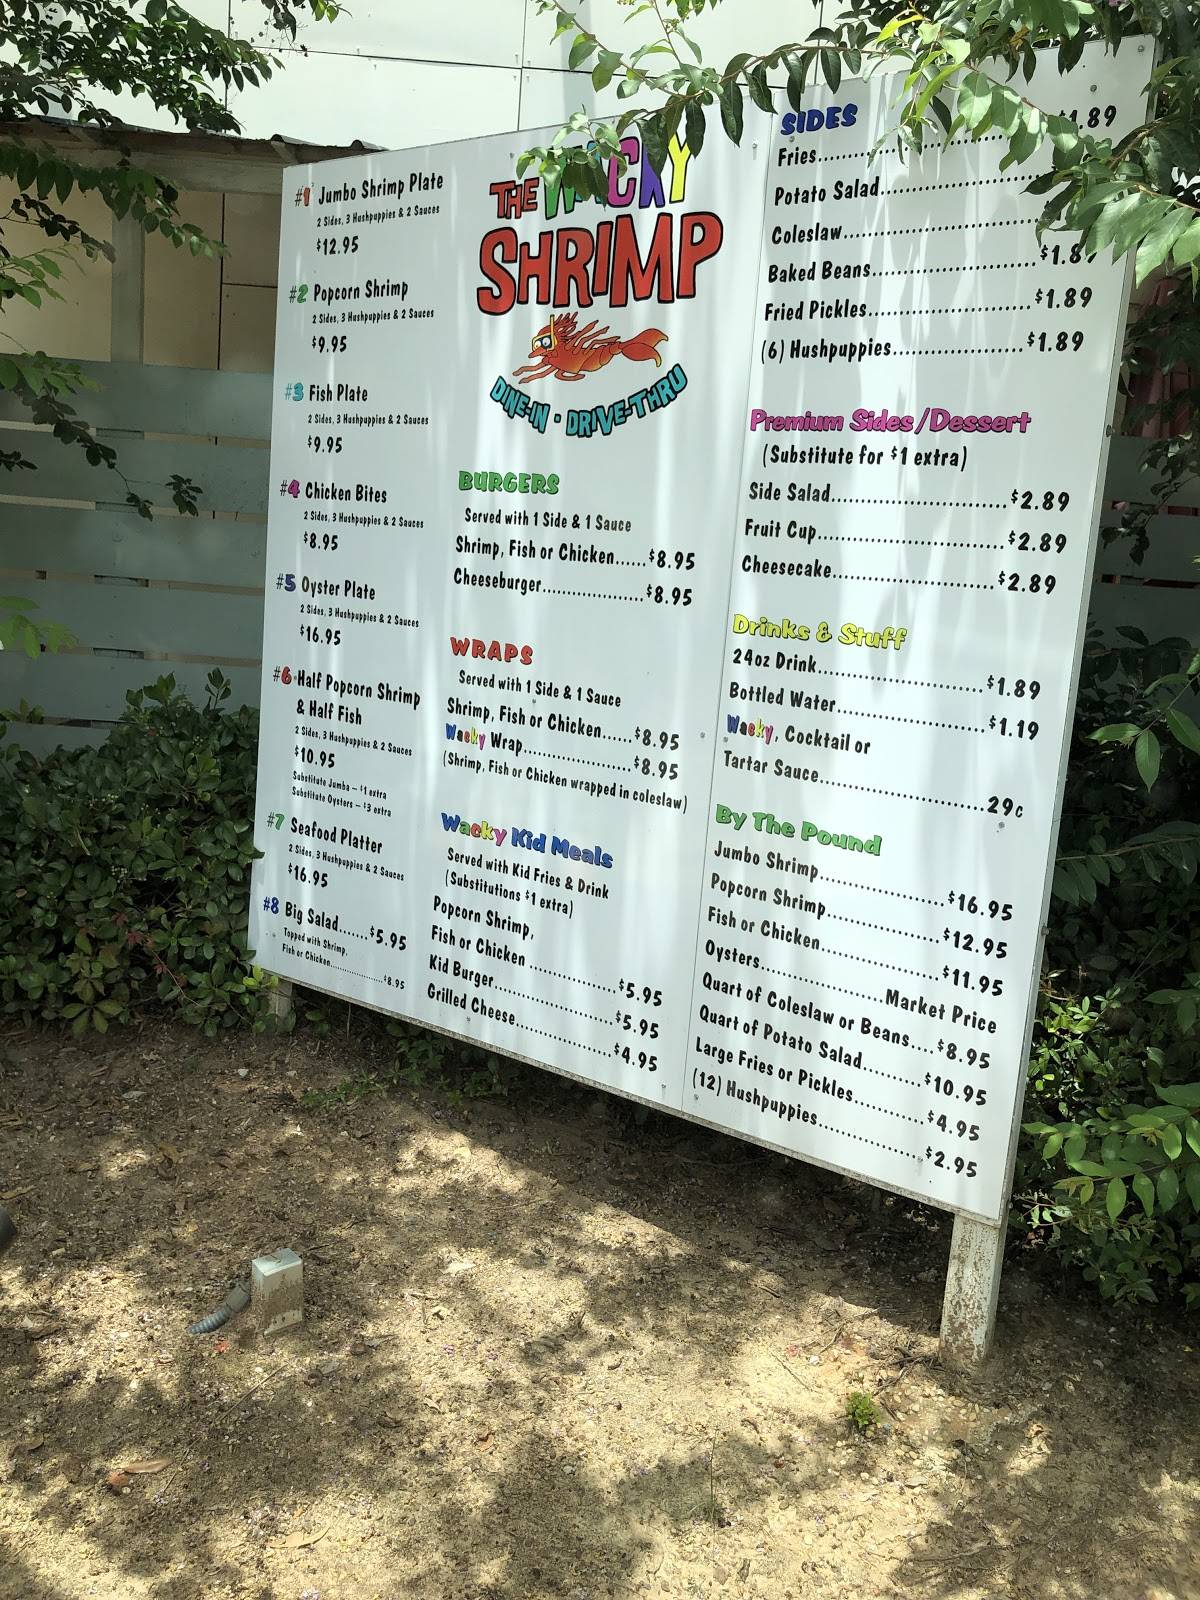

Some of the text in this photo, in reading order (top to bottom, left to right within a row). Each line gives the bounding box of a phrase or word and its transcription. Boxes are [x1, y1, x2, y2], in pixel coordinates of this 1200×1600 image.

[778, 104, 1117, 167] Fries 1.89
[780, 103, 858, 135] SIDES
[295, 172, 443, 207] #1 Jumbo Shrimp Plate
[490, 176, 539, 219] THE
[775, 176, 880, 206] Potato Salad
[317, 217, 321, 227] 2
[346, 214, 350, 224] 3
[353, 209, 395, 224] Hushpuppies
[398, 207, 404, 218] &
[407, 206, 411, 217] 2
[414, 205, 439, 216] Sauces
[772, 222, 842, 245] Coleslaw
[316, 235, 358, 255] $12.95
[477, 211, 724, 316] SHRIMP
[768, 243, 1098, 283] Baked Beans $1.8
[289, 278, 408, 306] #2 Popcorn Shrimp
[765, 287, 1092, 321] Fried Pickles $1.89
[312, 336, 347, 353] $9.95
[762, 331, 1084, 364] (6) Hushpuppies $1.89
[285, 383, 367, 402] #3 Fish Plate
[489, 363, 687, 438] DINE-IN DRIVE-THRU
[750, 409, 844, 432] Premium
[308, 435, 342, 453] $9.95
[763, 443, 967, 472] (Substitute for $1 extra)
[280, 479, 387, 503] #4 Chicken Bites
[459, 471, 559, 495] BURGERS
[749, 482, 1069, 512] Side Salad $2.89
[304, 531, 338, 551] $8.95
[745, 518, 1067, 554] Fruit Cup $2.89
[509, 539, 536, 558] Fish
[540, 547, 553, 560] or
[559, 543, 614, 564] Chicken
[649, 548, 695, 570] $8.95
[276, 573, 375, 600] #5 Oyster Plate
[454, 568, 692, 606] Cheeseburger $8.95
[742, 554, 1056, 595] Cheesecake $2.89
[300, 624, 341, 646] $16.95
[733, 614, 907, 650] Drinks & Stuff
[450, 637, 533, 665] WRAPS
[273, 666, 420, 710] #6 Half Popcorn Shrimp
[733, 648, 1040, 700] 24oz Drink $1.89
[730, 682, 1039, 740] Bottled Water $1.19
[295, 745, 335, 768] $10.95
[446, 723, 678, 780] Wacky Wrap $8.95
[785, 725, 850, 751] Cocktail
[855, 741, 870, 754] or
[724, 750, 768, 773] Tartar
[774, 759, 818, 782] Sauce
[267, 812, 382, 854] #7 Seafood Platter
[441, 813, 613, 869] Wacky Kid Meals
[716, 804, 882, 856] By The Pound
[288, 862, 328, 888] $16.95
[448, 847, 608, 899] Served with Kid Fries & Drink
[714, 840, 1012, 921] Jumbo Shrimp $16.95
[434, 895, 481, 923] Popcorn
[446, 869, 573, 919] (Substitutions $1 extra)
[263, 896, 406, 951] #8 Big Salad $5.95
[711, 873, 1007, 959] Popcorn Shrimp $12.95
[284, 927, 305, 942] Topped
[307, 936, 320, 947] with
[282, 943, 295, 955] Fish
[305, 951, 332, 967] Chicken
[384, 974, 404, 989] $8.95
[429, 954, 659, 1039] Kid Burger $5.95
[706, 939, 996, 1033] Oysters Market Price
[428, 983, 657, 1072] Grilled Cheese $4.95
[696, 1036, 979, 1141] Large Fries or Pickles $4.95
[693, 1068, 977, 1177] (12) Hushpuppies $2.95
